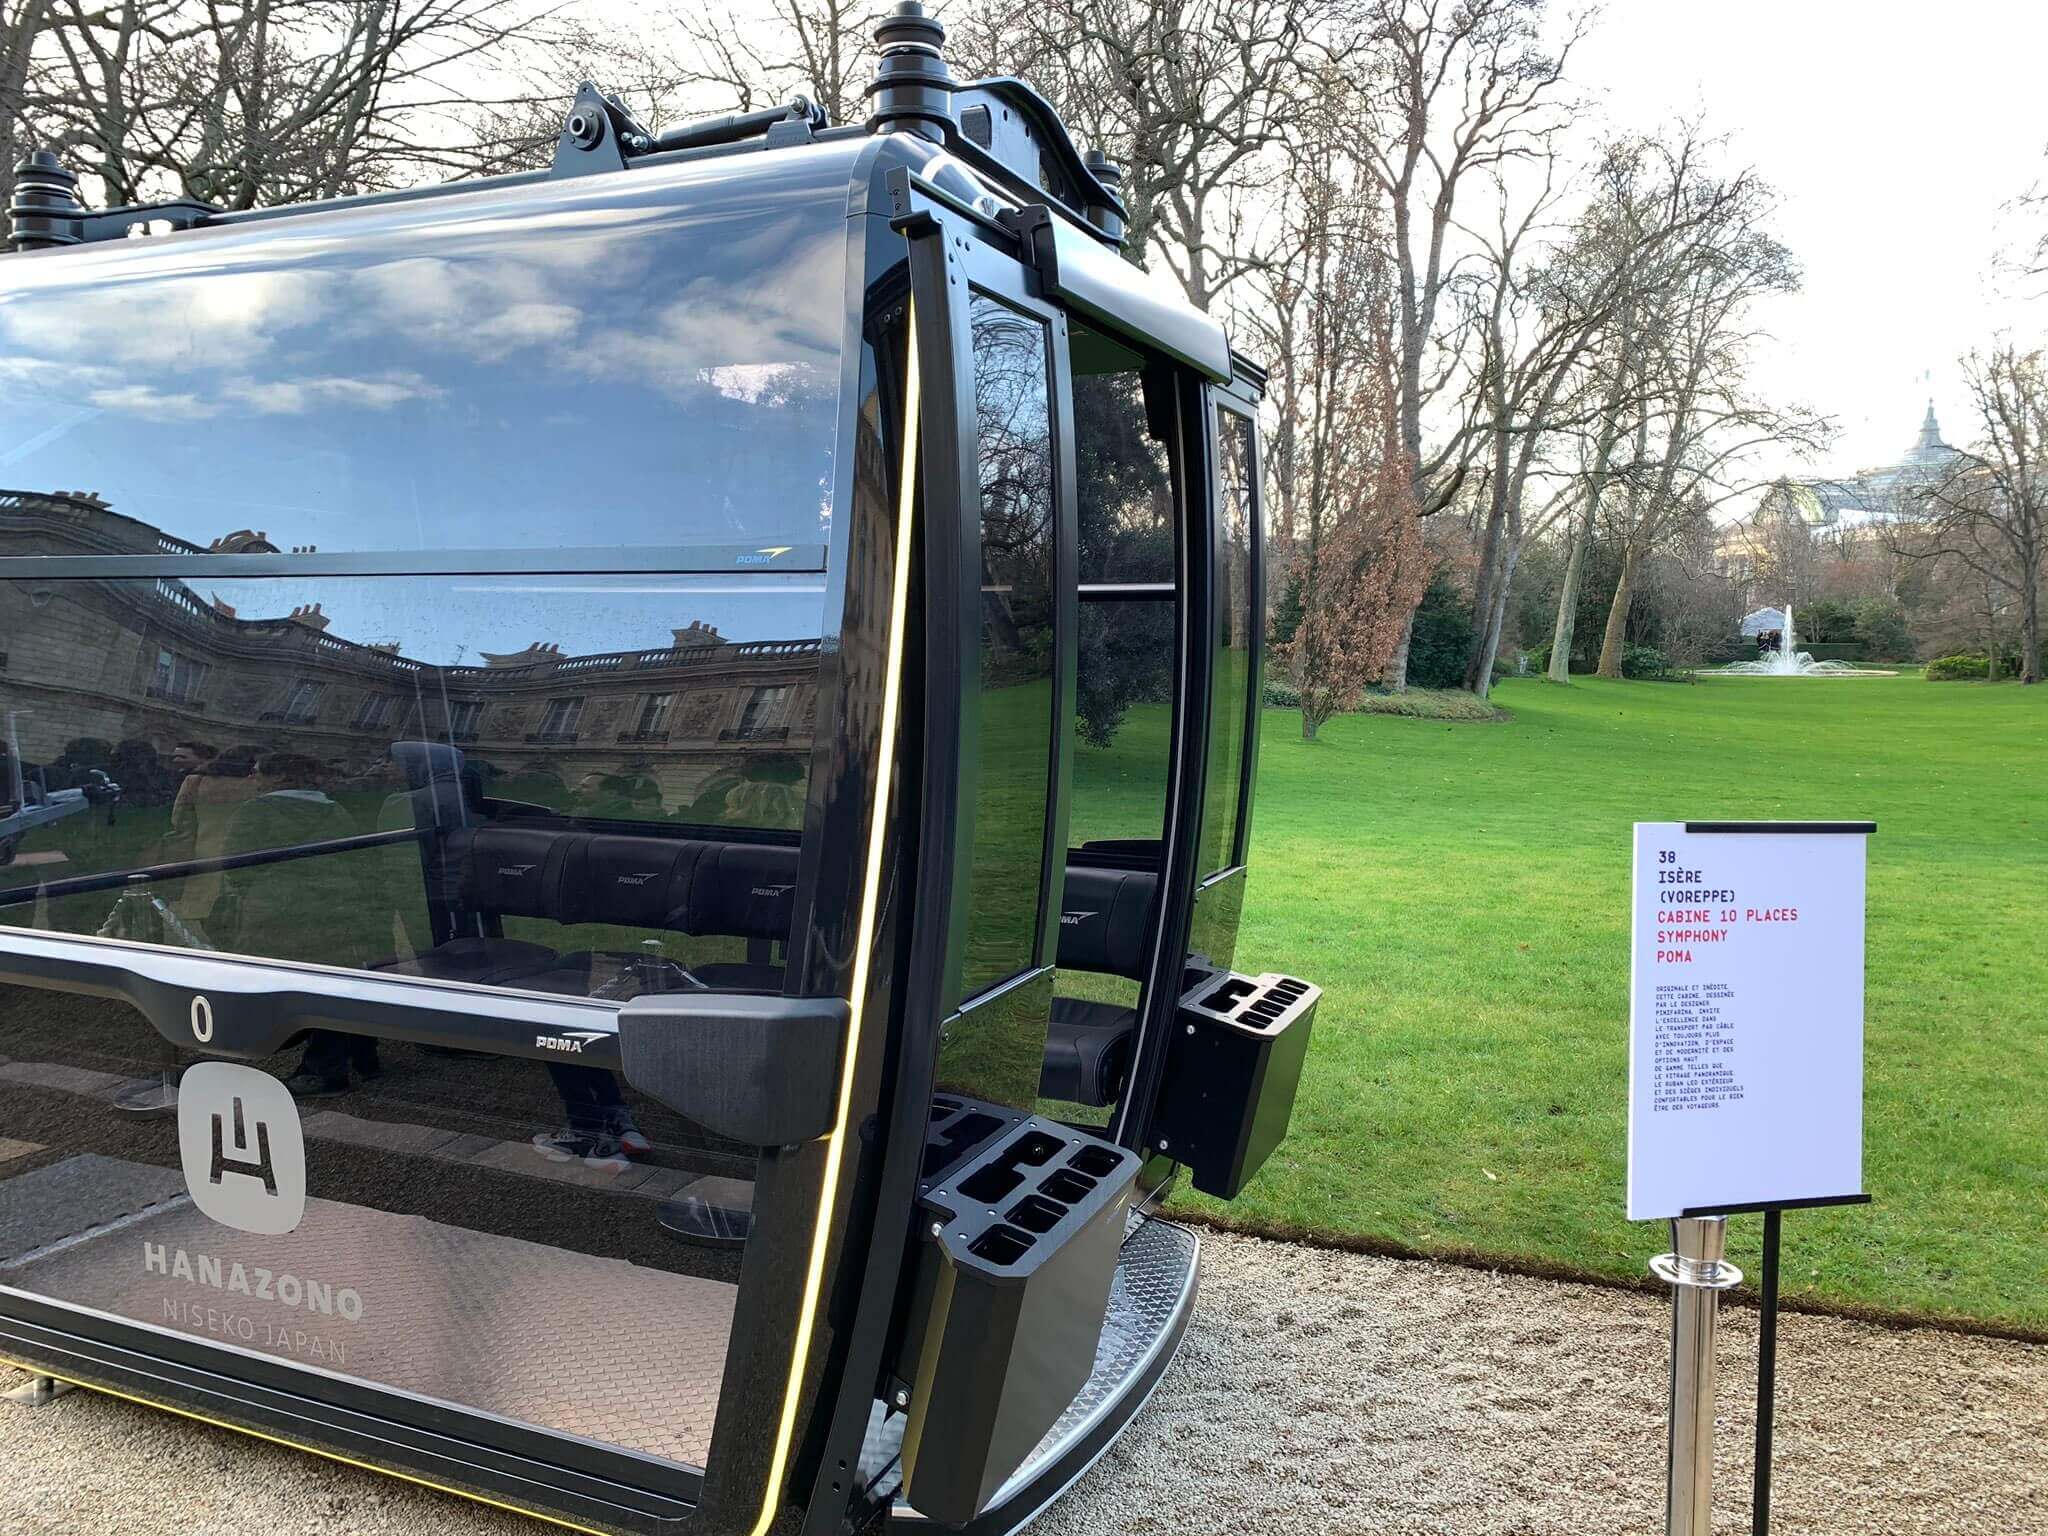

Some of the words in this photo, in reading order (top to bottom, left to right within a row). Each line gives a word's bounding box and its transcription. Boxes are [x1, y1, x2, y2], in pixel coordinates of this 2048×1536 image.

[1658, 851, 1676, 863] 38
[1658, 867, 1702, 883] ISÈRE
[752, 887, 779, 897] POMA
[1660, 890, 1735, 903] (VOREPPE)
[1658, 910, 1710, 923] CABINE
[1720, 910, 1737, 922] 10
[1746, 908, 1798, 922] PLACES
[1657, 930, 1728, 943] SYMPHONY
[1657, 950, 1692, 963] POMA
[536, 1036, 582, 1052] POMA
[144, 1242, 363, 1321] HANAZONO
[163, 1298, 254, 1339] NISEKO
[265, 1324, 345, 1364] JAPAN
